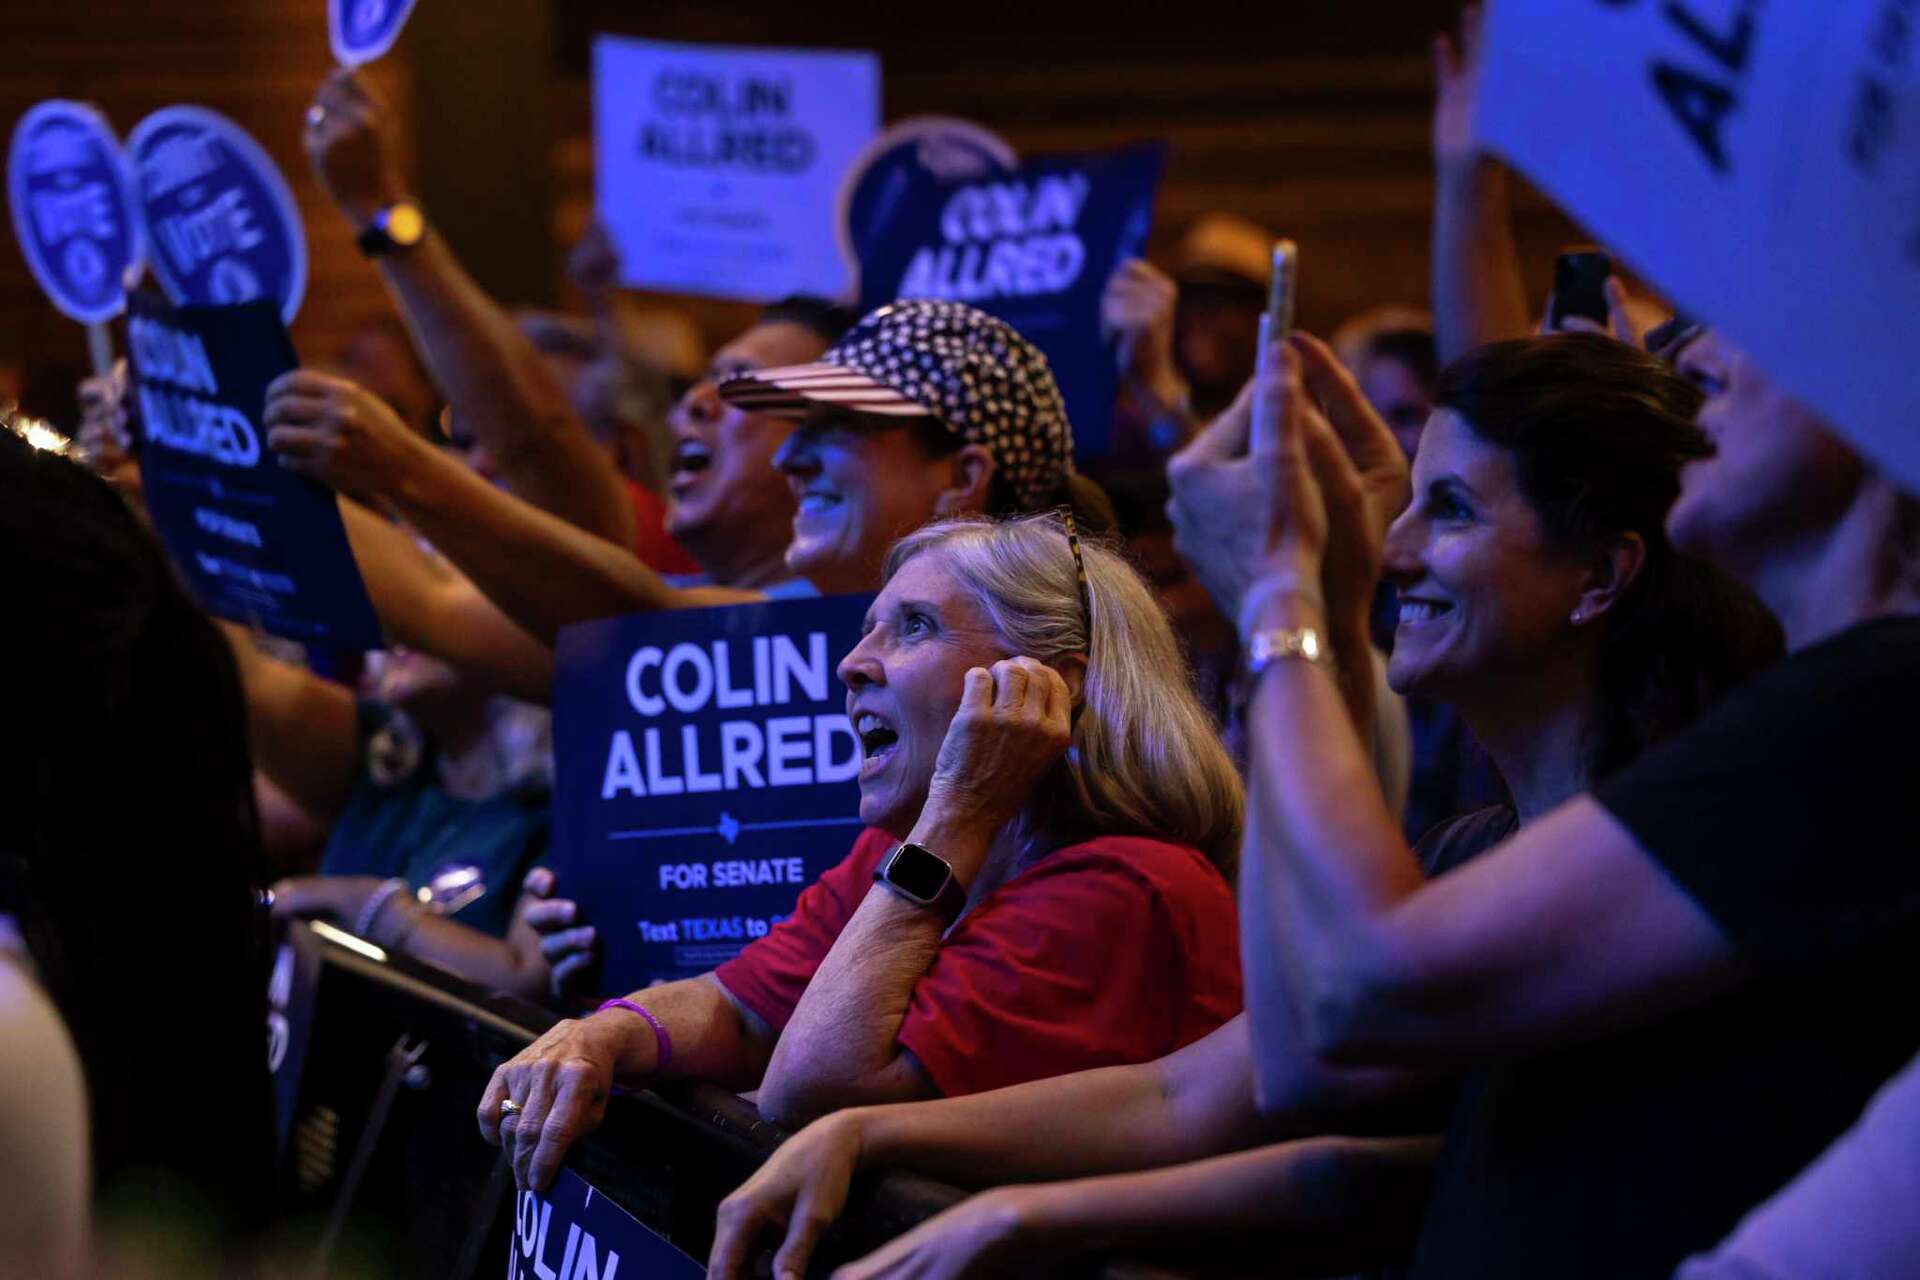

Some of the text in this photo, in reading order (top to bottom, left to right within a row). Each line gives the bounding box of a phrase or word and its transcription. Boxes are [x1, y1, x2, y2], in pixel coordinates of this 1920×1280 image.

[940, 171, 1090, 244] COLIN
[897, 233, 1086, 301] ALLRED
[626, 632, 829, 717] COLIN
[601, 714, 864, 799] ALLRED
[659, 856, 805, 891] FOR SENATE
[637, 919, 679, 943] Text
[681, 916, 743, 941] TEXAS
[744, 915, 769, 938] to
